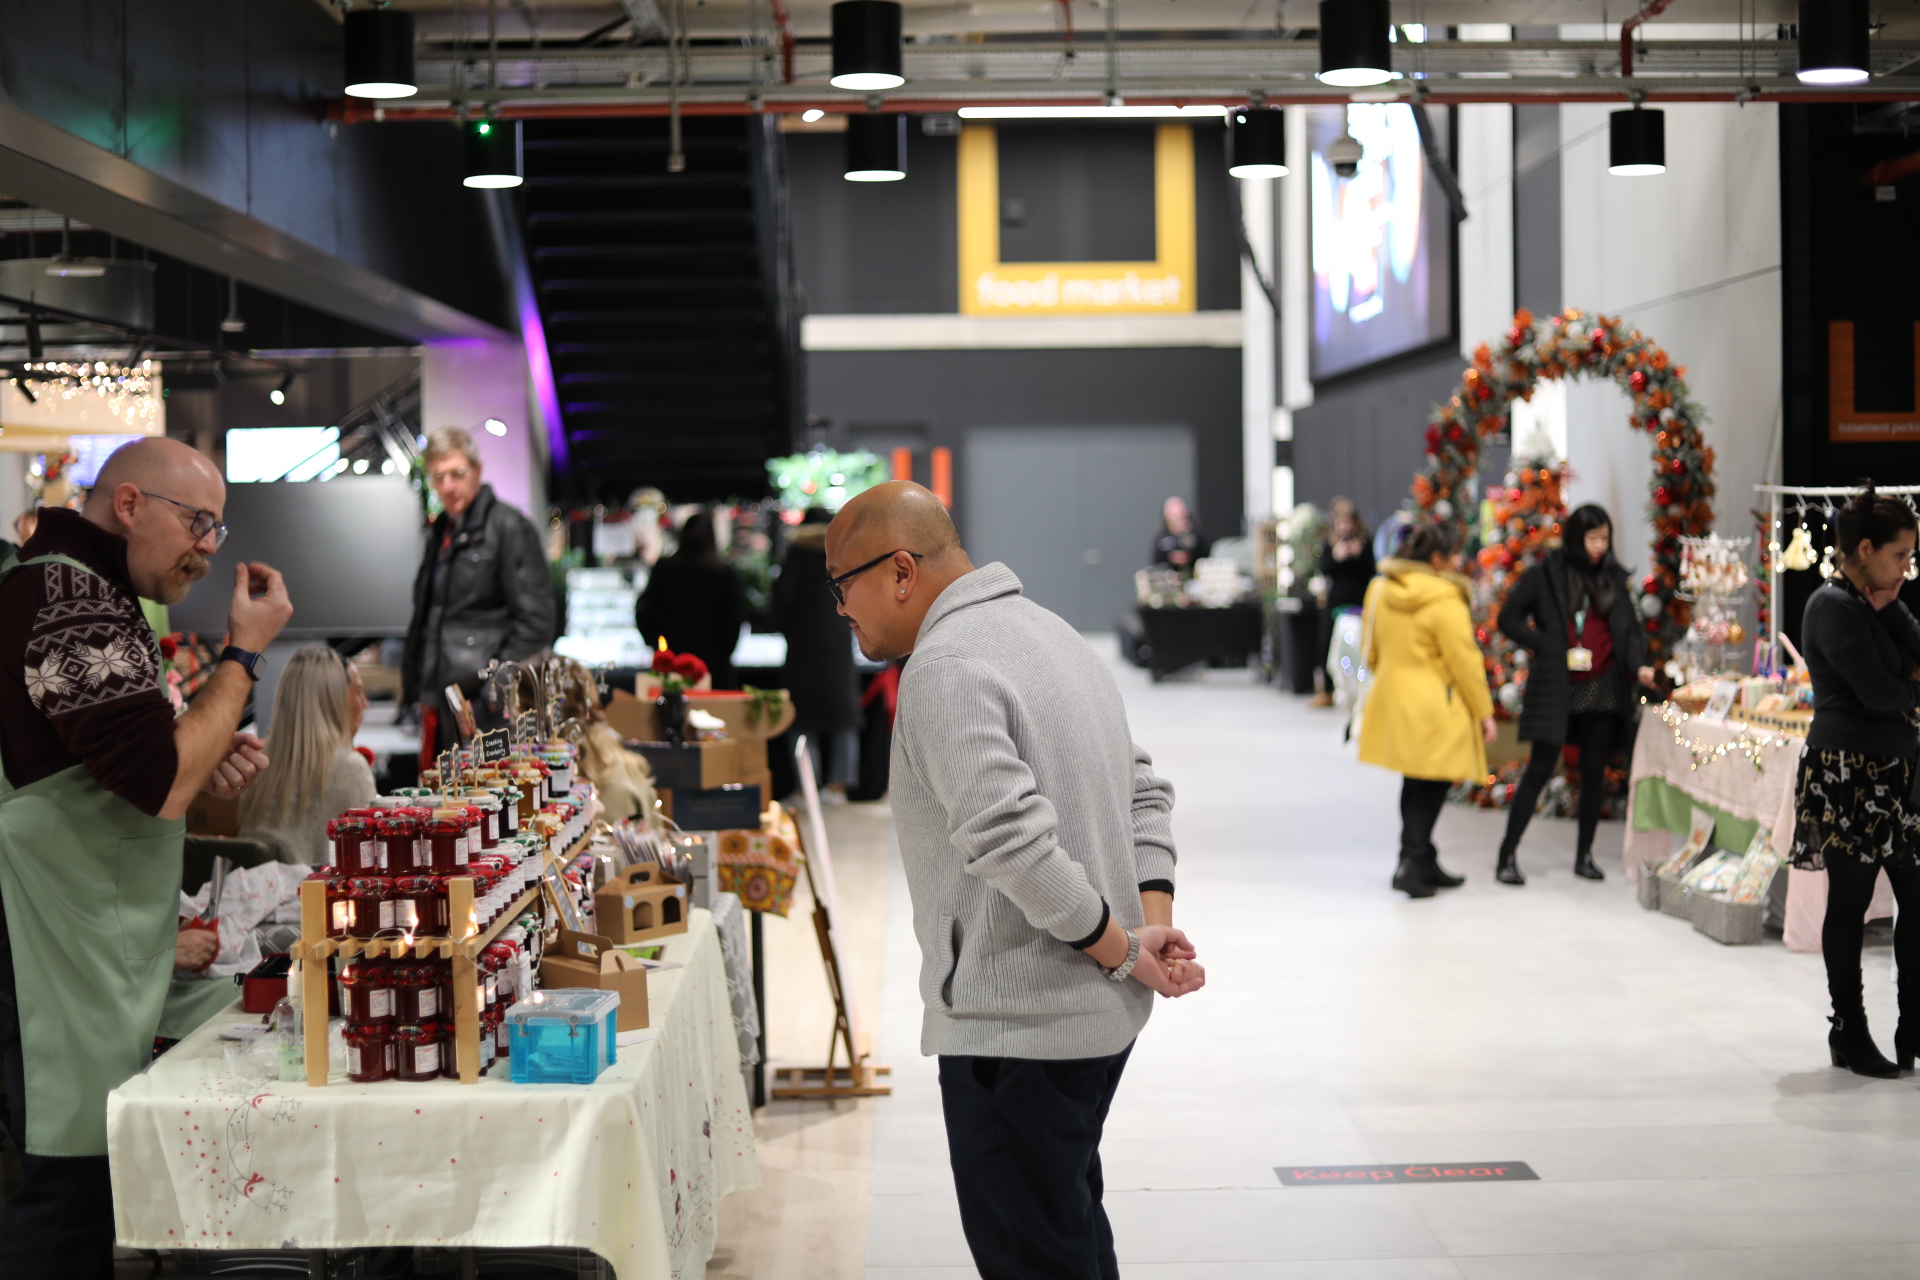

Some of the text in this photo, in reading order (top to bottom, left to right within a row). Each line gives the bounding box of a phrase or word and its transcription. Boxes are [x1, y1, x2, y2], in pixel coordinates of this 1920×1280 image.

[975, 271, 1183, 307] food market
[486, 748, 506, 757] Cranberry
[1292, 1166, 1509, 1182] Keep Clear
